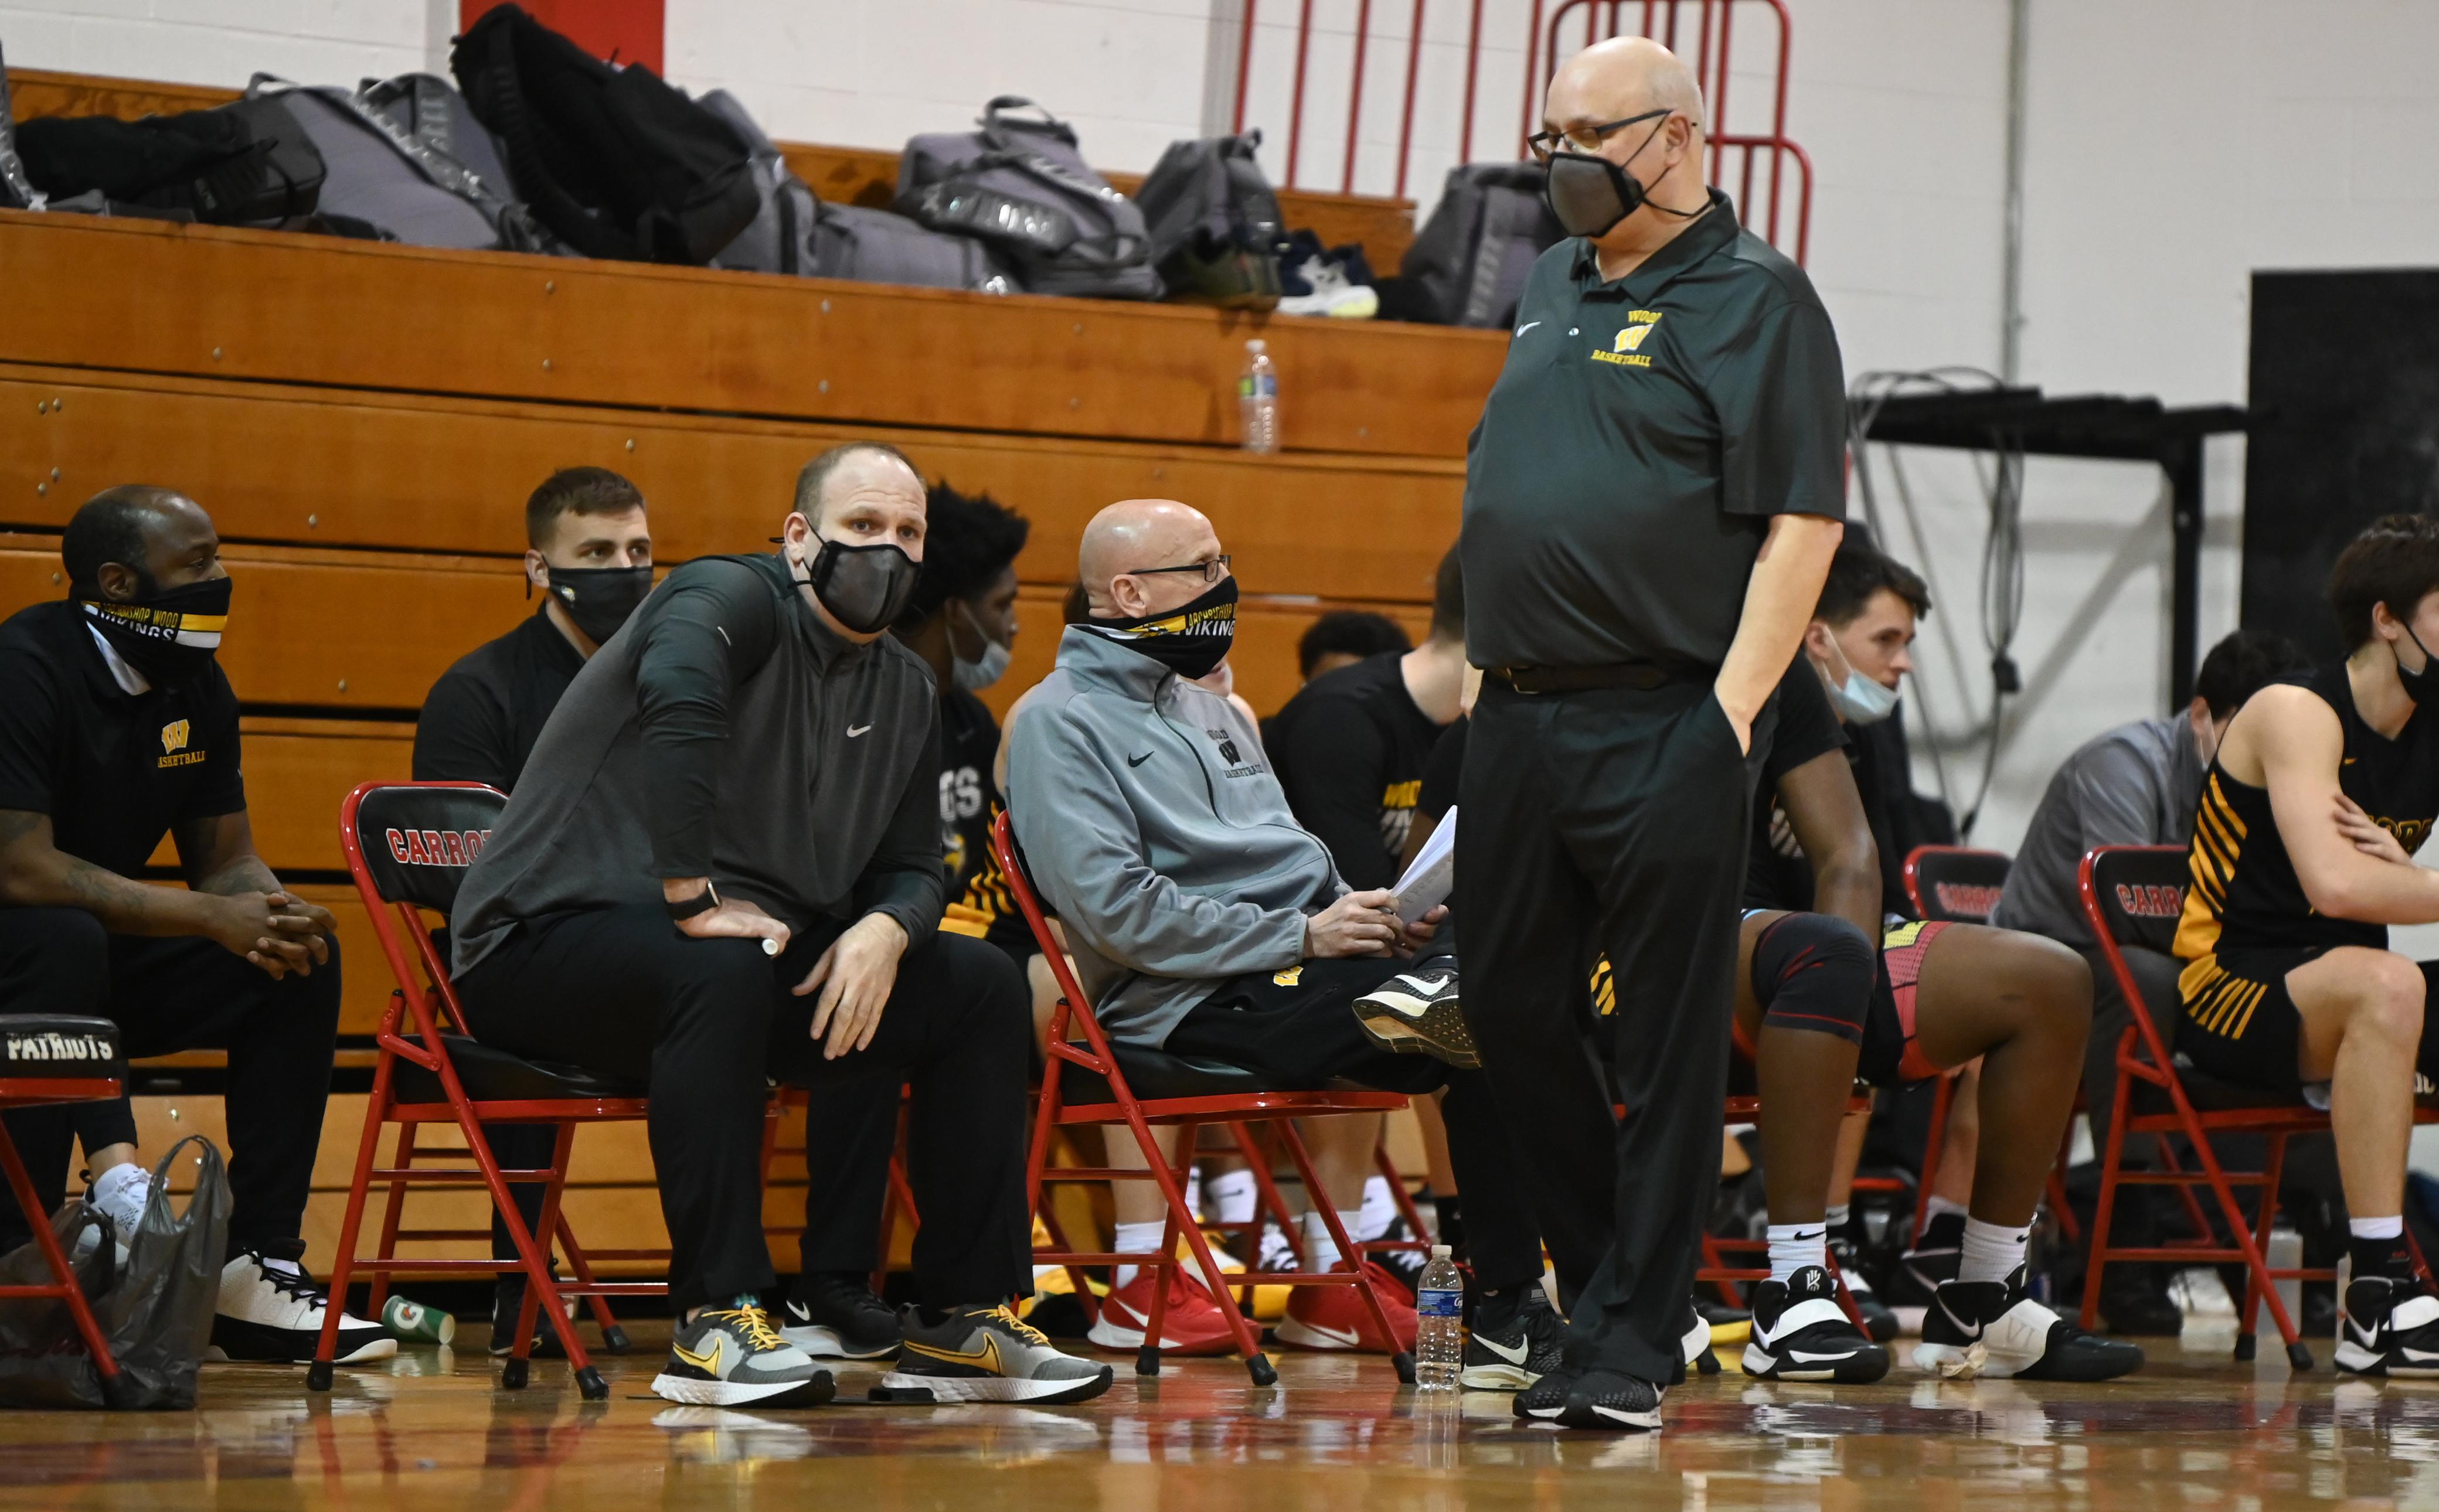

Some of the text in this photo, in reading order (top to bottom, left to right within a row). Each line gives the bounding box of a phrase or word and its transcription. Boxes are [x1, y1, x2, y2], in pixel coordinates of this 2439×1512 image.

[103, 602, 179, 628] HBISHOP WOOD
[161, 718, 191, 755] W
[157, 751, 206, 768] ASKETBALL
[1218, 739, 1242, 768] W
[386, 828, 492, 867] CARRO
[2116, 883, 2184, 917] CARR
